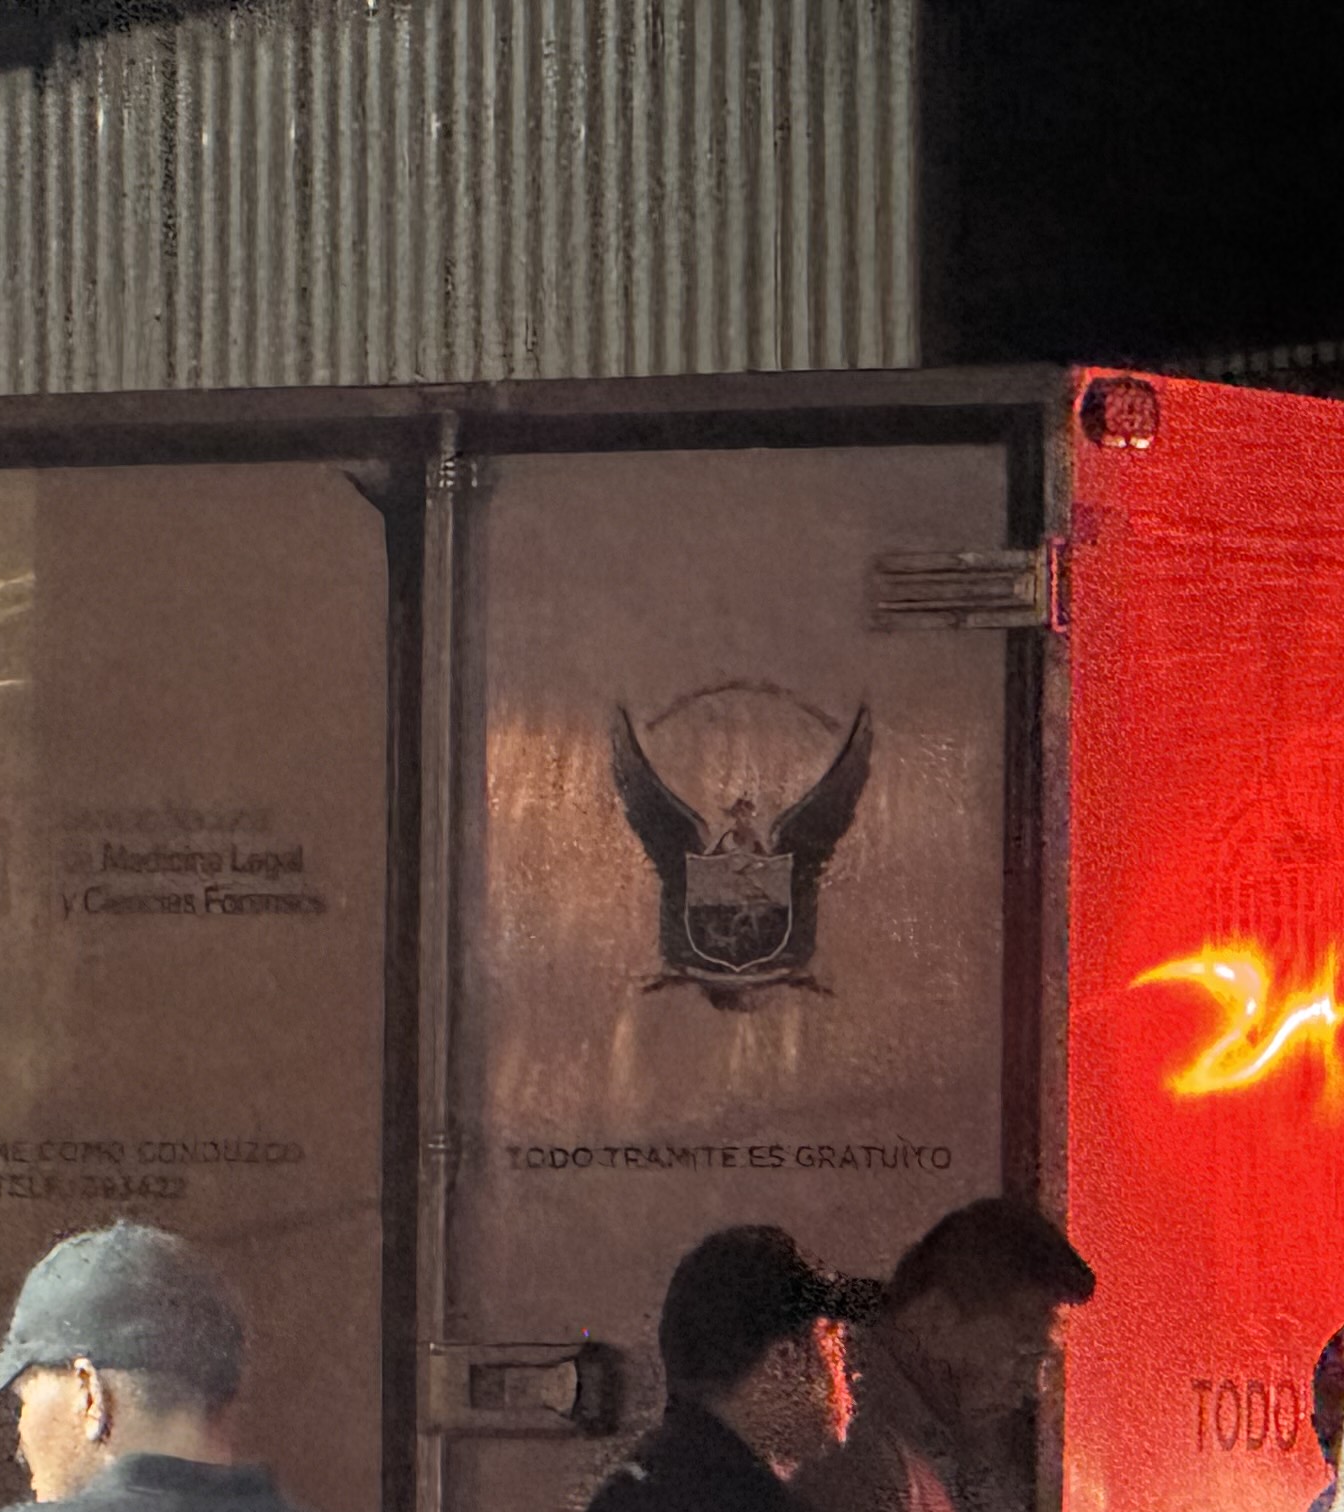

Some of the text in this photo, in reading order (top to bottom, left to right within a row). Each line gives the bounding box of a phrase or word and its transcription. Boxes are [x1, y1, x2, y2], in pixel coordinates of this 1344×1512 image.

[507, 1146, 594, 1170] TODO
[748, 1145, 786, 1169] ES
[1190, 1378, 1300, 1451] TODO
